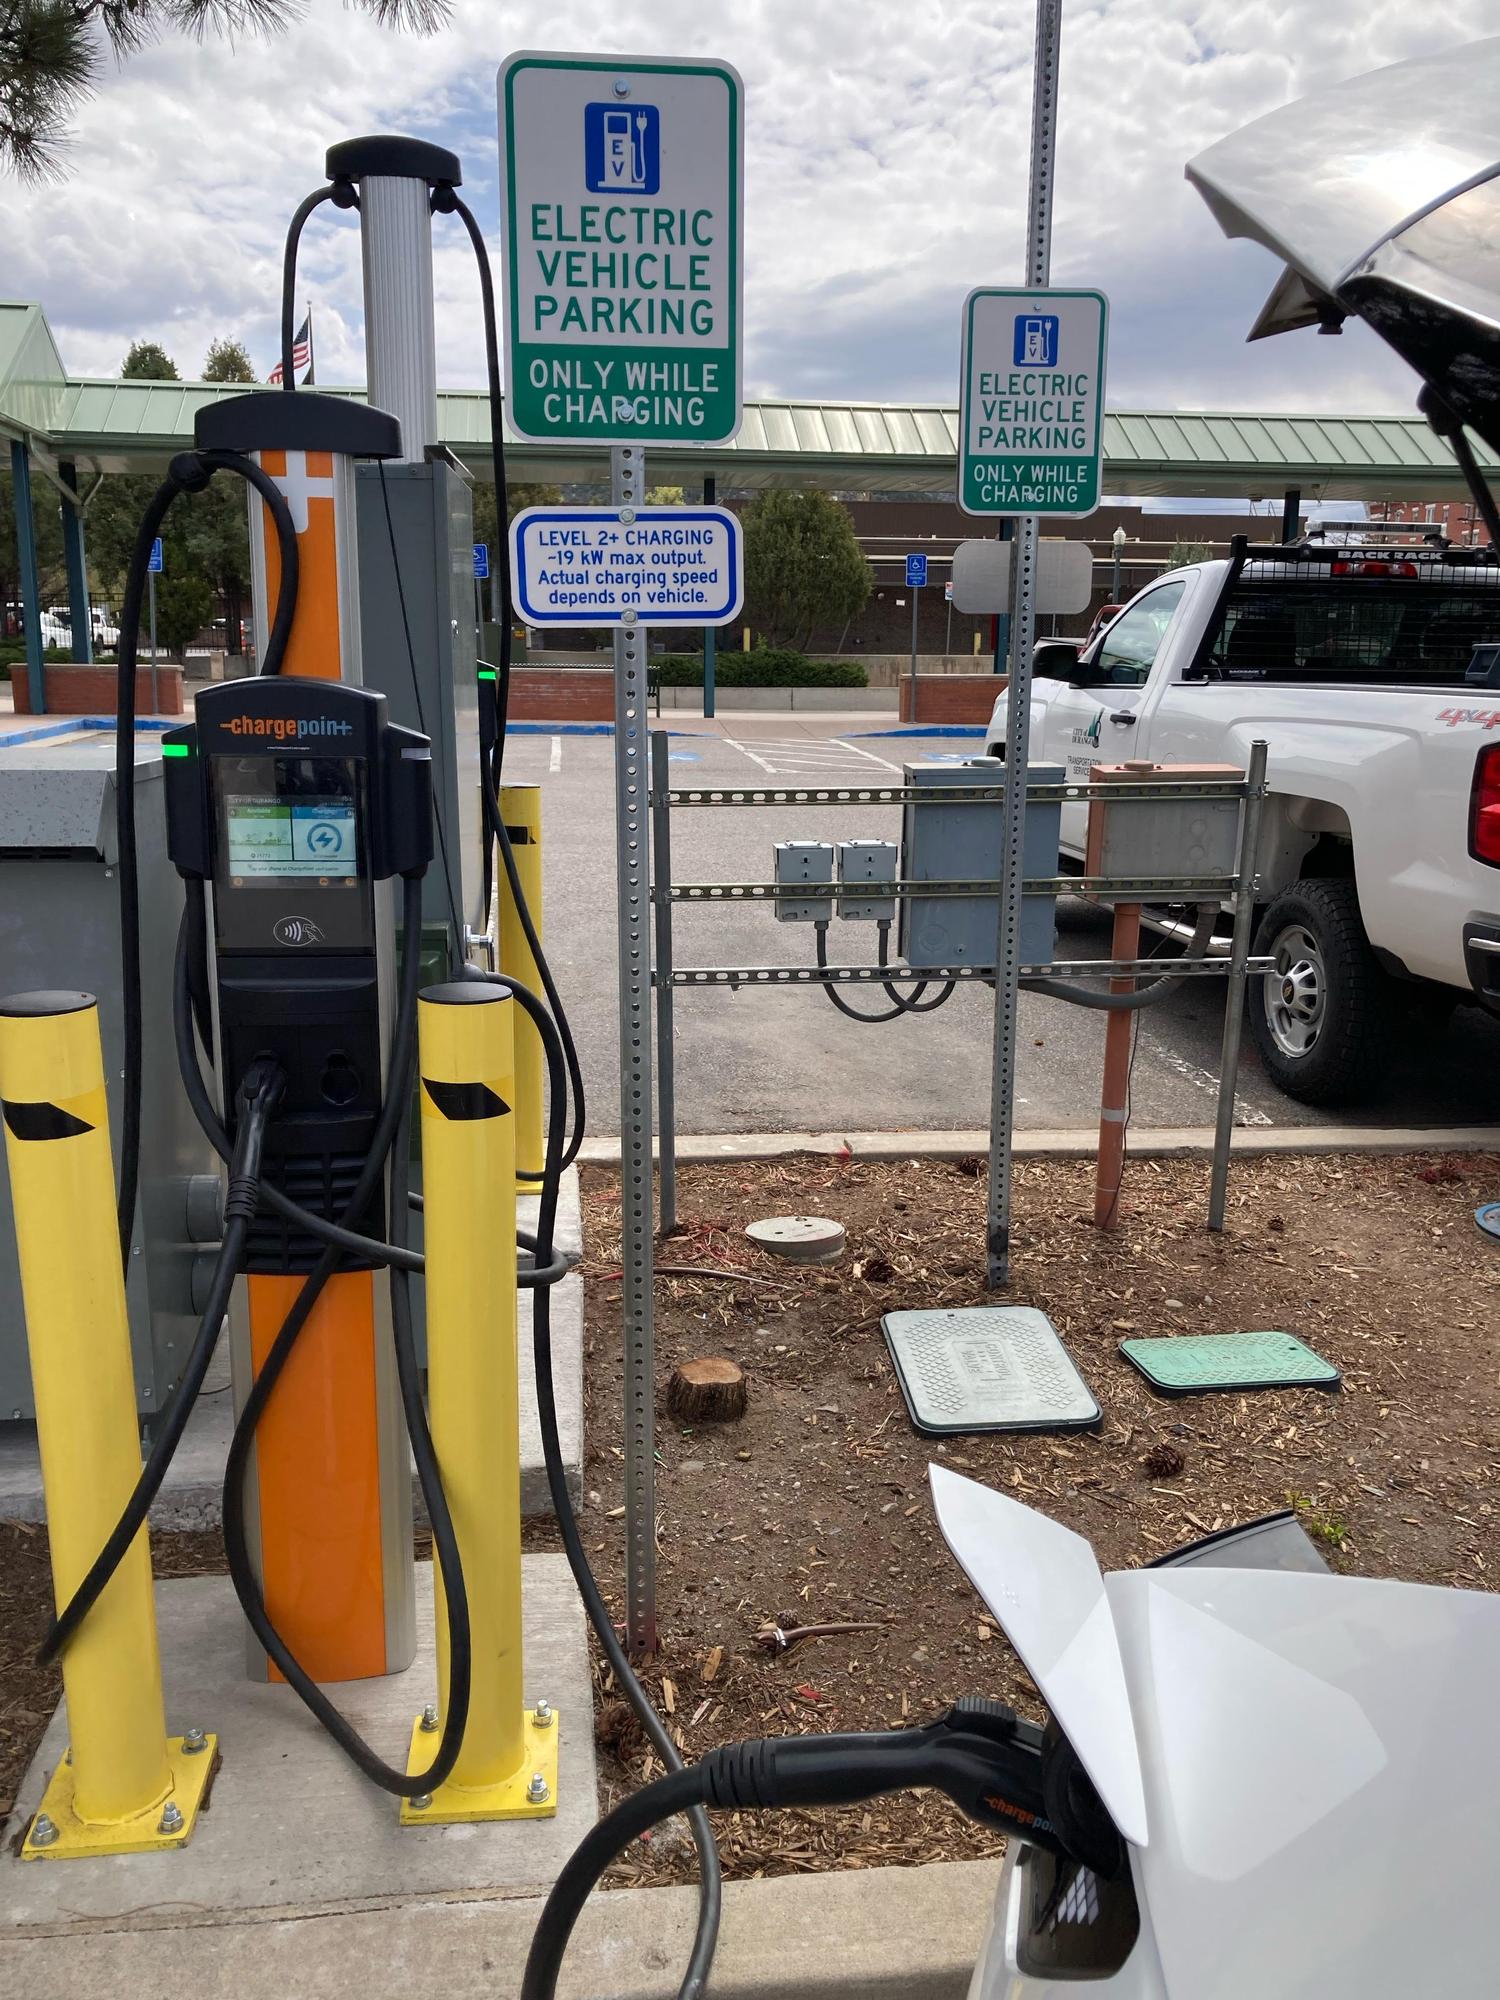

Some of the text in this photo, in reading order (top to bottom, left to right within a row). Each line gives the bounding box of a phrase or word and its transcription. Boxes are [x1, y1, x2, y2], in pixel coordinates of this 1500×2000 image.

[531, 204, 714, 247] ELECTRIC
[536, 250, 711, 291] VEHICLE
[534, 295, 714, 336] PARKING
[529, 359, 719, 393] ONLY WHILE
[979, 373, 1088, 396] ELECTRIC
[543, 394, 705, 426] CHARGING
[982, 400, 1085, 423] VEHICLE
[978, 427, 1086, 449] PARKING
[973, 464, 1087, 483] ONLY WHILE
[981, 485, 1078, 503] CHARGING
[539, 530, 713, 546] LEVEL 2+ CHARGING
[581, 551, 603, 565] kW
[610, 552, 645, 565] max
[651, 550, 706, 567] output.
[538, 569, 718, 588] Actual charging speed
[549, 589, 708, 607] depends on vehicle.
